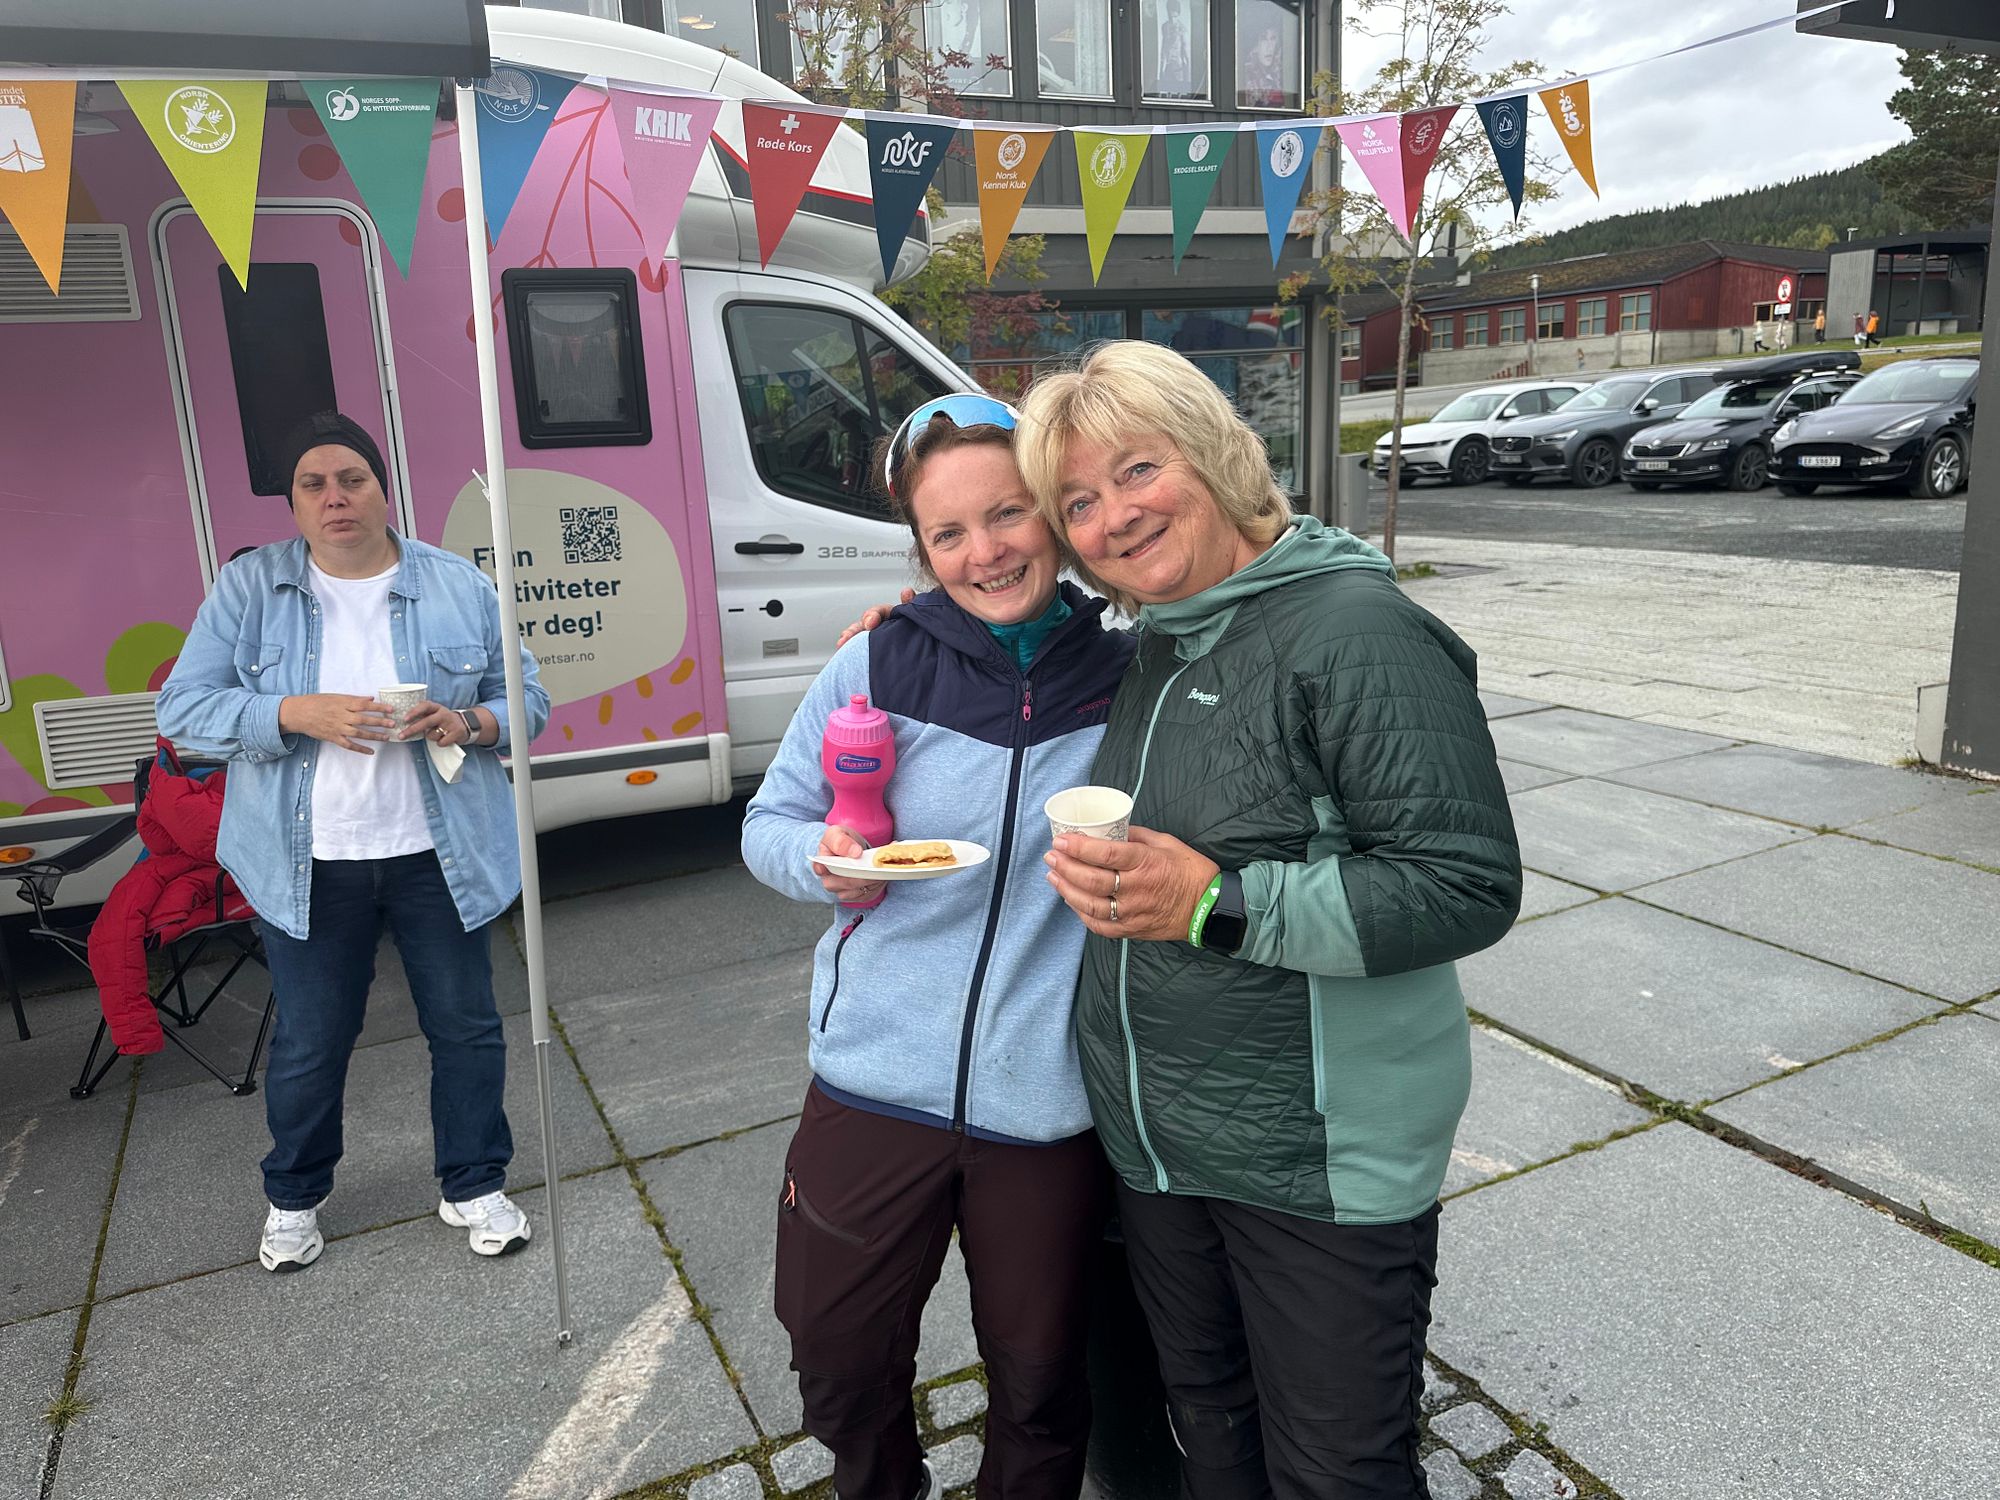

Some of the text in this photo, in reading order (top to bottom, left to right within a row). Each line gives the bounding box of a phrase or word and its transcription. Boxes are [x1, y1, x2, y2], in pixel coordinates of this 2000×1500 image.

[180, 91, 209, 99] NORSK
[635, 106, 693, 141] KRIK
[180, 132, 228, 150] ORIENTERING
[756, 137, 813, 154] Røde Kors
[1361, 139, 1384, 148] NORSK
[1356, 145, 1394, 157] FRILUFTSLIV
[995, 171, 1018, 180] Norsk
[1173, 164, 1218, 175] SKOGSELSKAPET
[982, 180, 1027, 191] Kennel Klub
[473, 547, 534, 569] Fin
[817, 546, 858, 559] 328
[495, 577, 622, 603] tiviteter
[544, 610, 603, 638] deg!
